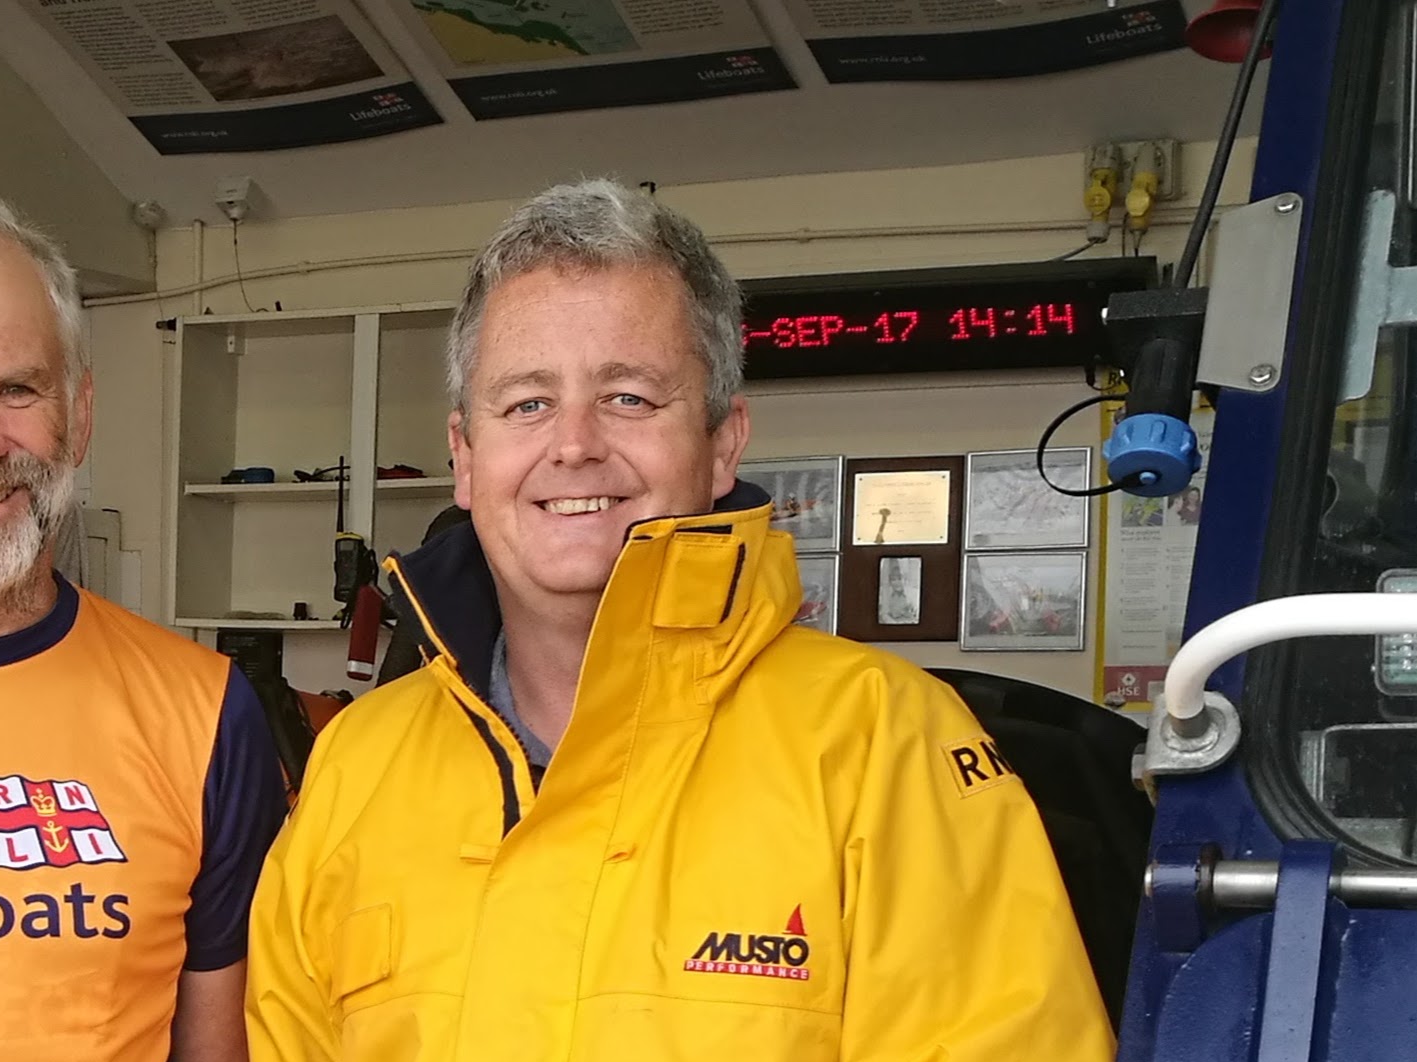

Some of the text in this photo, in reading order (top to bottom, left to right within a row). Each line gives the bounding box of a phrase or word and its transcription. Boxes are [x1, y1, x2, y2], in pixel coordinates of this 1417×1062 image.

[1086, 23, 1162, 44] Lifeboats
[697, 66, 765, 80] Lifeboats
[349, 103, 412, 121] Lifeboats
[948, 303, 1073, 340] 14:14
[1117, 686, 1140, 696] HSE
[64, 784, 86, 806] N
[6, 837, 29, 862] L
[691, 931, 810, 967] MUSTO
[685, 960, 809, 980] PERFORMANCE
